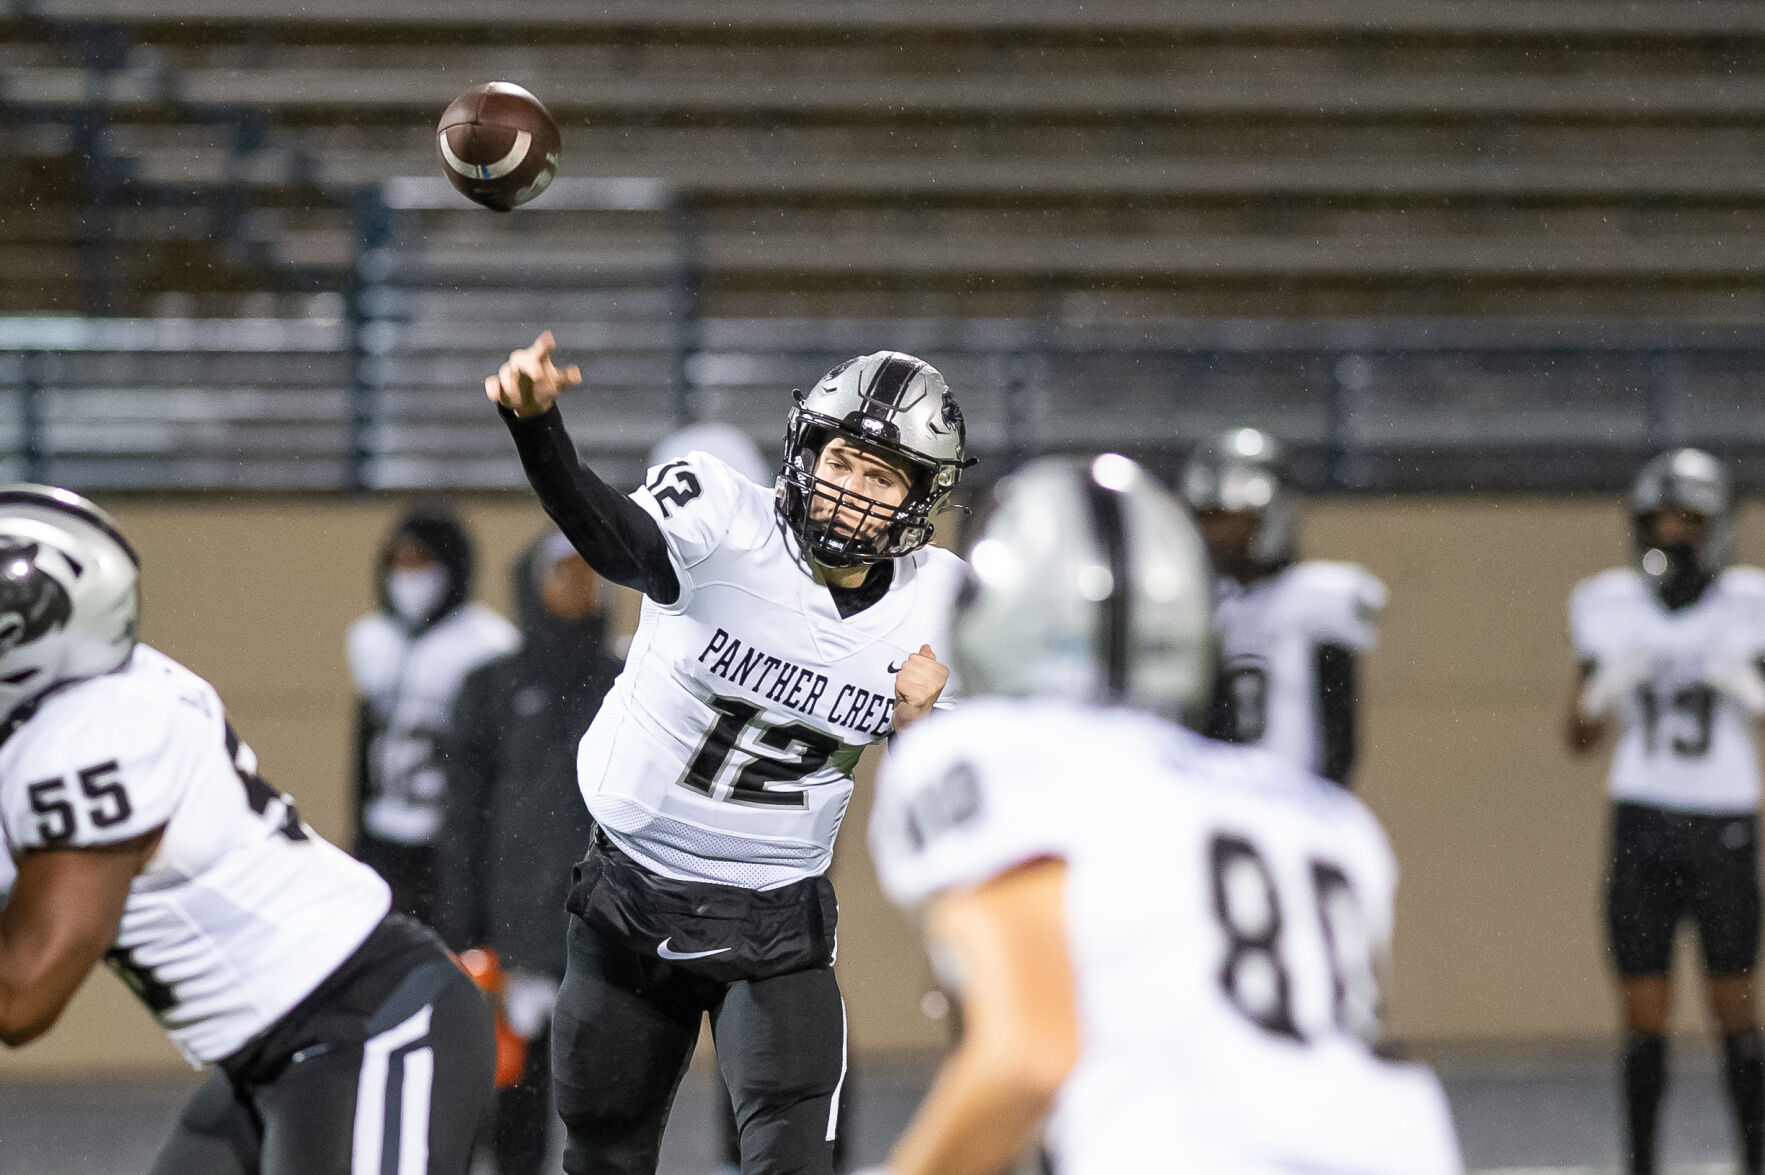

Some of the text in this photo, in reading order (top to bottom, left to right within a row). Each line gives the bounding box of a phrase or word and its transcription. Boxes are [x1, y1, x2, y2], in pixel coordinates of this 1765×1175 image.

[698, 627, 896, 737] PANTHER CREE
[27, 759, 133, 843] 55
[675, 694, 844, 811] 12
